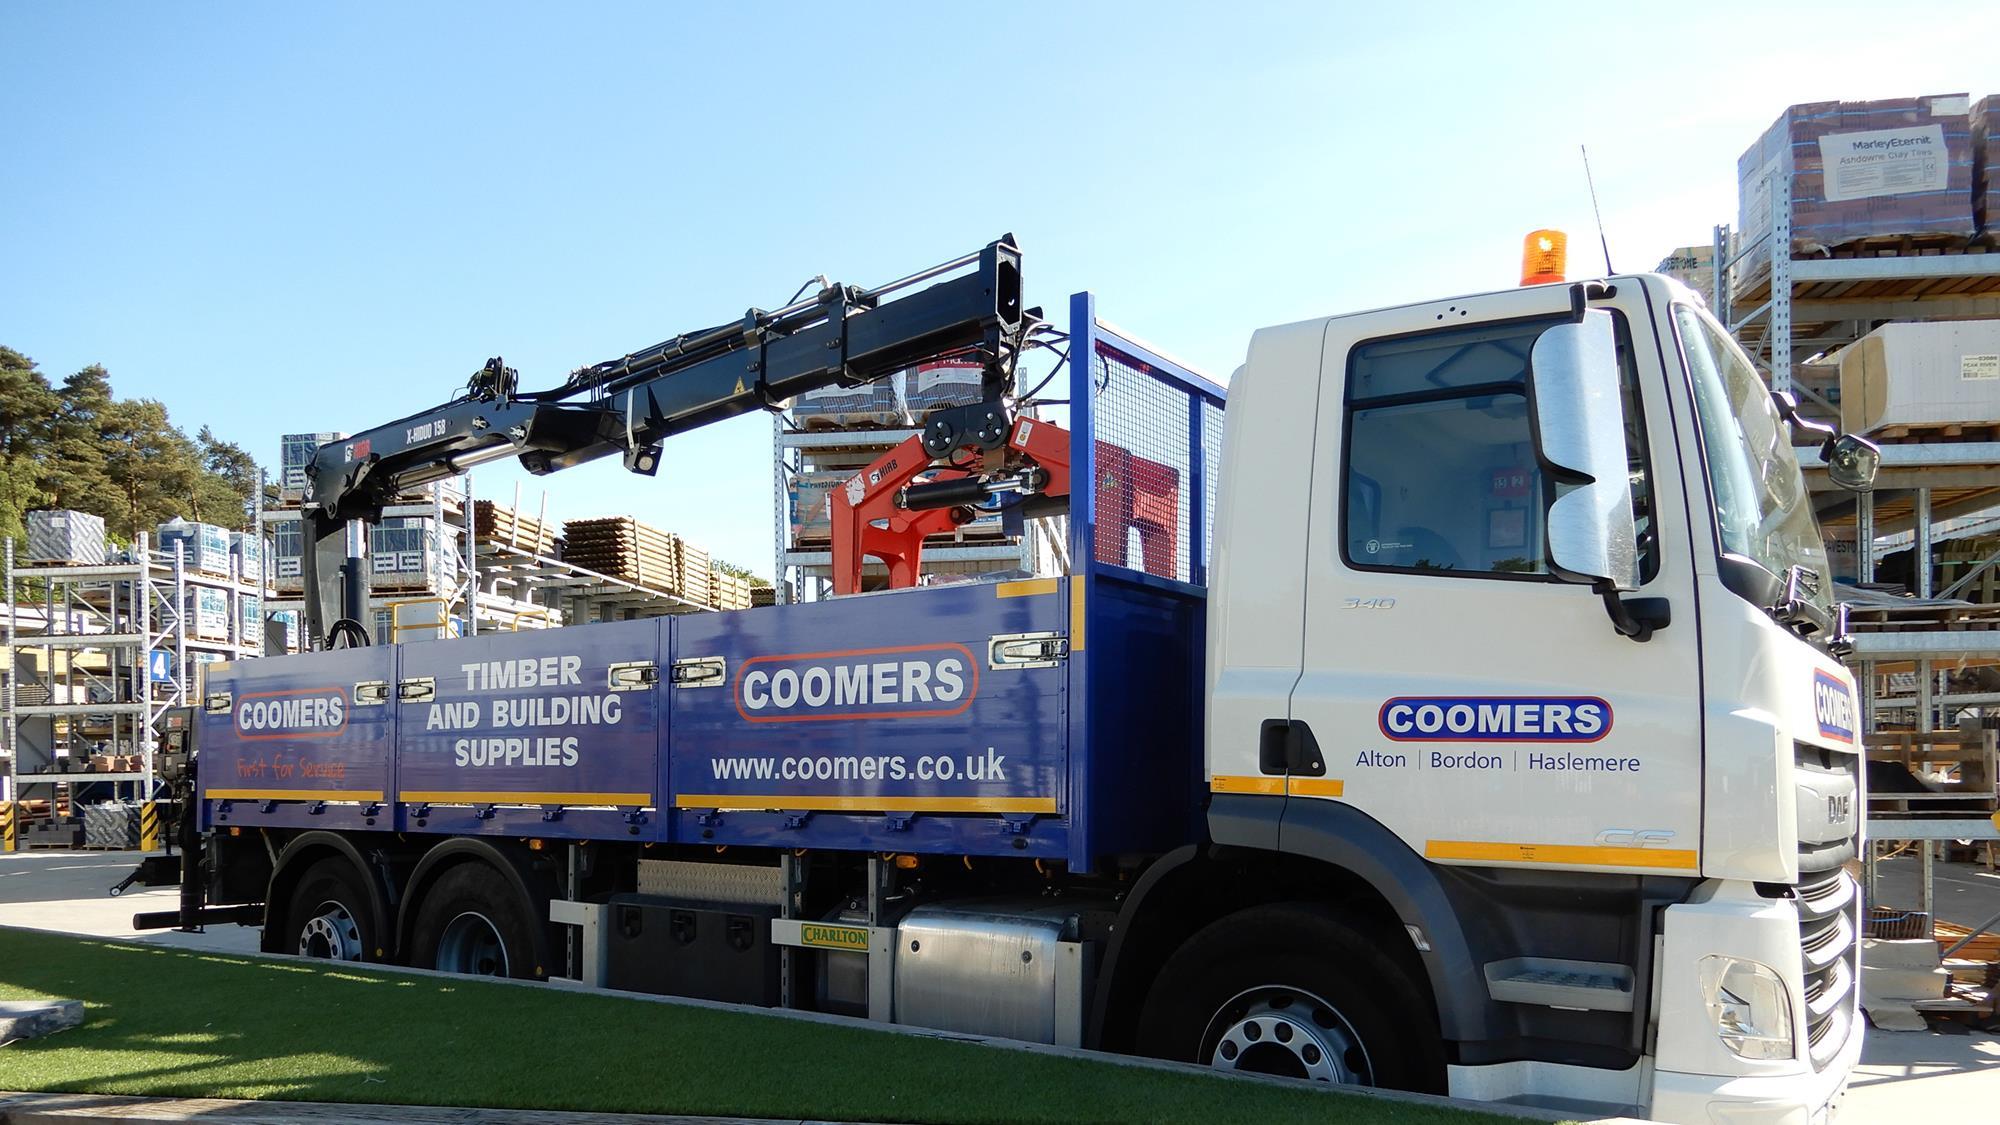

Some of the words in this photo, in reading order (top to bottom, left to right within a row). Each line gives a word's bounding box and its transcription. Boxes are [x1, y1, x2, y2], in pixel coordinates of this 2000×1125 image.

[1852, 135, 1932, 151] MarleyEternit
[406, 422, 433, 445] X-HIDUO
[433, 419, 446, 437] 158
[879, 459, 898, 478] HIAB
[1340, 597, 1396, 610] 340
[152, 653, 166, 680] 4
[461, 655, 582, 691] TIMBER
[743, 658, 964, 710] COOMERS
[239, 697, 343, 730] COOMERS
[426, 702, 481, 730] AND
[492, 694, 622, 728] BUILDING
[1387, 704, 1602, 734] COOMERS
[1816, 681, 1853, 732] COOMERS
[455, 736, 579, 767] SUPPLIES
[711, 747, 1006, 780] www.coomers.co.uk
[1356, 751, 1406, 768] Alton
[1431, 751, 1502, 769] Bordon
[1529, 752, 1641, 772] Haslemere
[237, 757, 267, 778] First
[272, 754, 295, 780] for
[300, 757, 345, 778] Service
[1828, 795, 1849, 825] DAF
[1594, 829, 1676, 848] CF
[803, 926, 866, 945] CHARLTON
